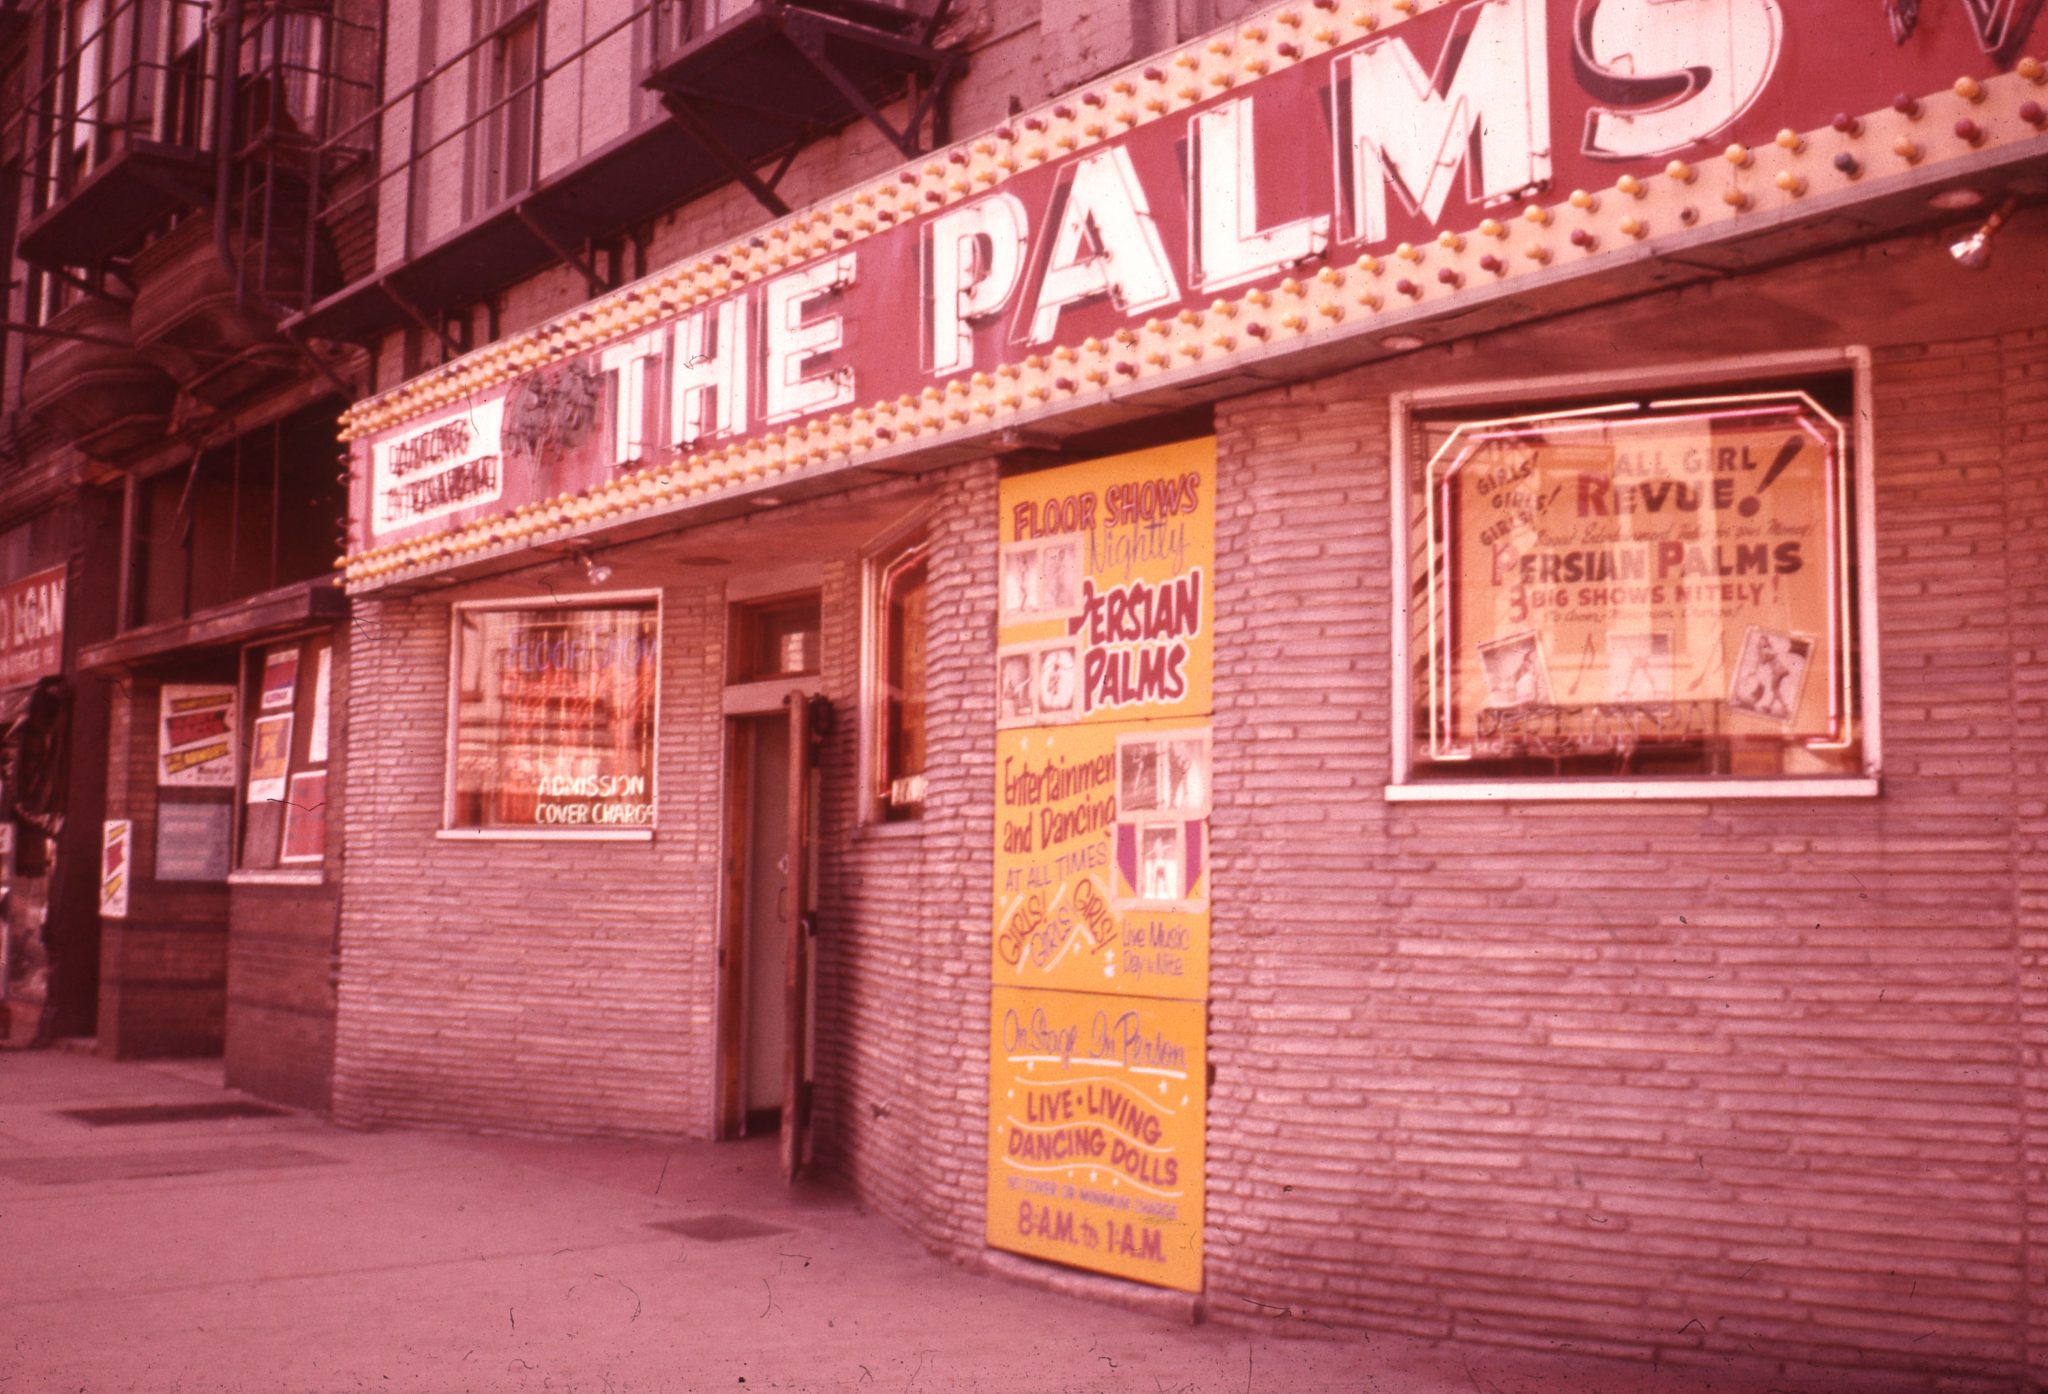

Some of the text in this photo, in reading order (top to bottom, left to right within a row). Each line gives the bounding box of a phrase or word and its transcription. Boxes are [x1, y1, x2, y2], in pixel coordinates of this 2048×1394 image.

[590, 0, 1784, 468] THE PALMS
[1013, 471, 1201, 543] FLOOR SHOWS
[1089, 520, 1192, 579] Nightly
[1491, 540, 1804, 587] PERSIAN PALMS
[1509, 584, 1529, 624] 3
[1069, 569, 1201, 713] PERSIAN PALMS
[536, 774, 645, 798] ADMISSION
[1003, 751, 1117, 806] Entertainmen
[535, 802, 589, 825] COVER
[1003, 793, 1117, 853] and Dancing
[1005, 840, 1108, 892] AT ALL TIMES
[1003, 1007, 1028, 1053] On
[1087, 1084, 1162, 1146] LIVING
[1008, 1127, 1179, 1187] DANCING DOLLS
